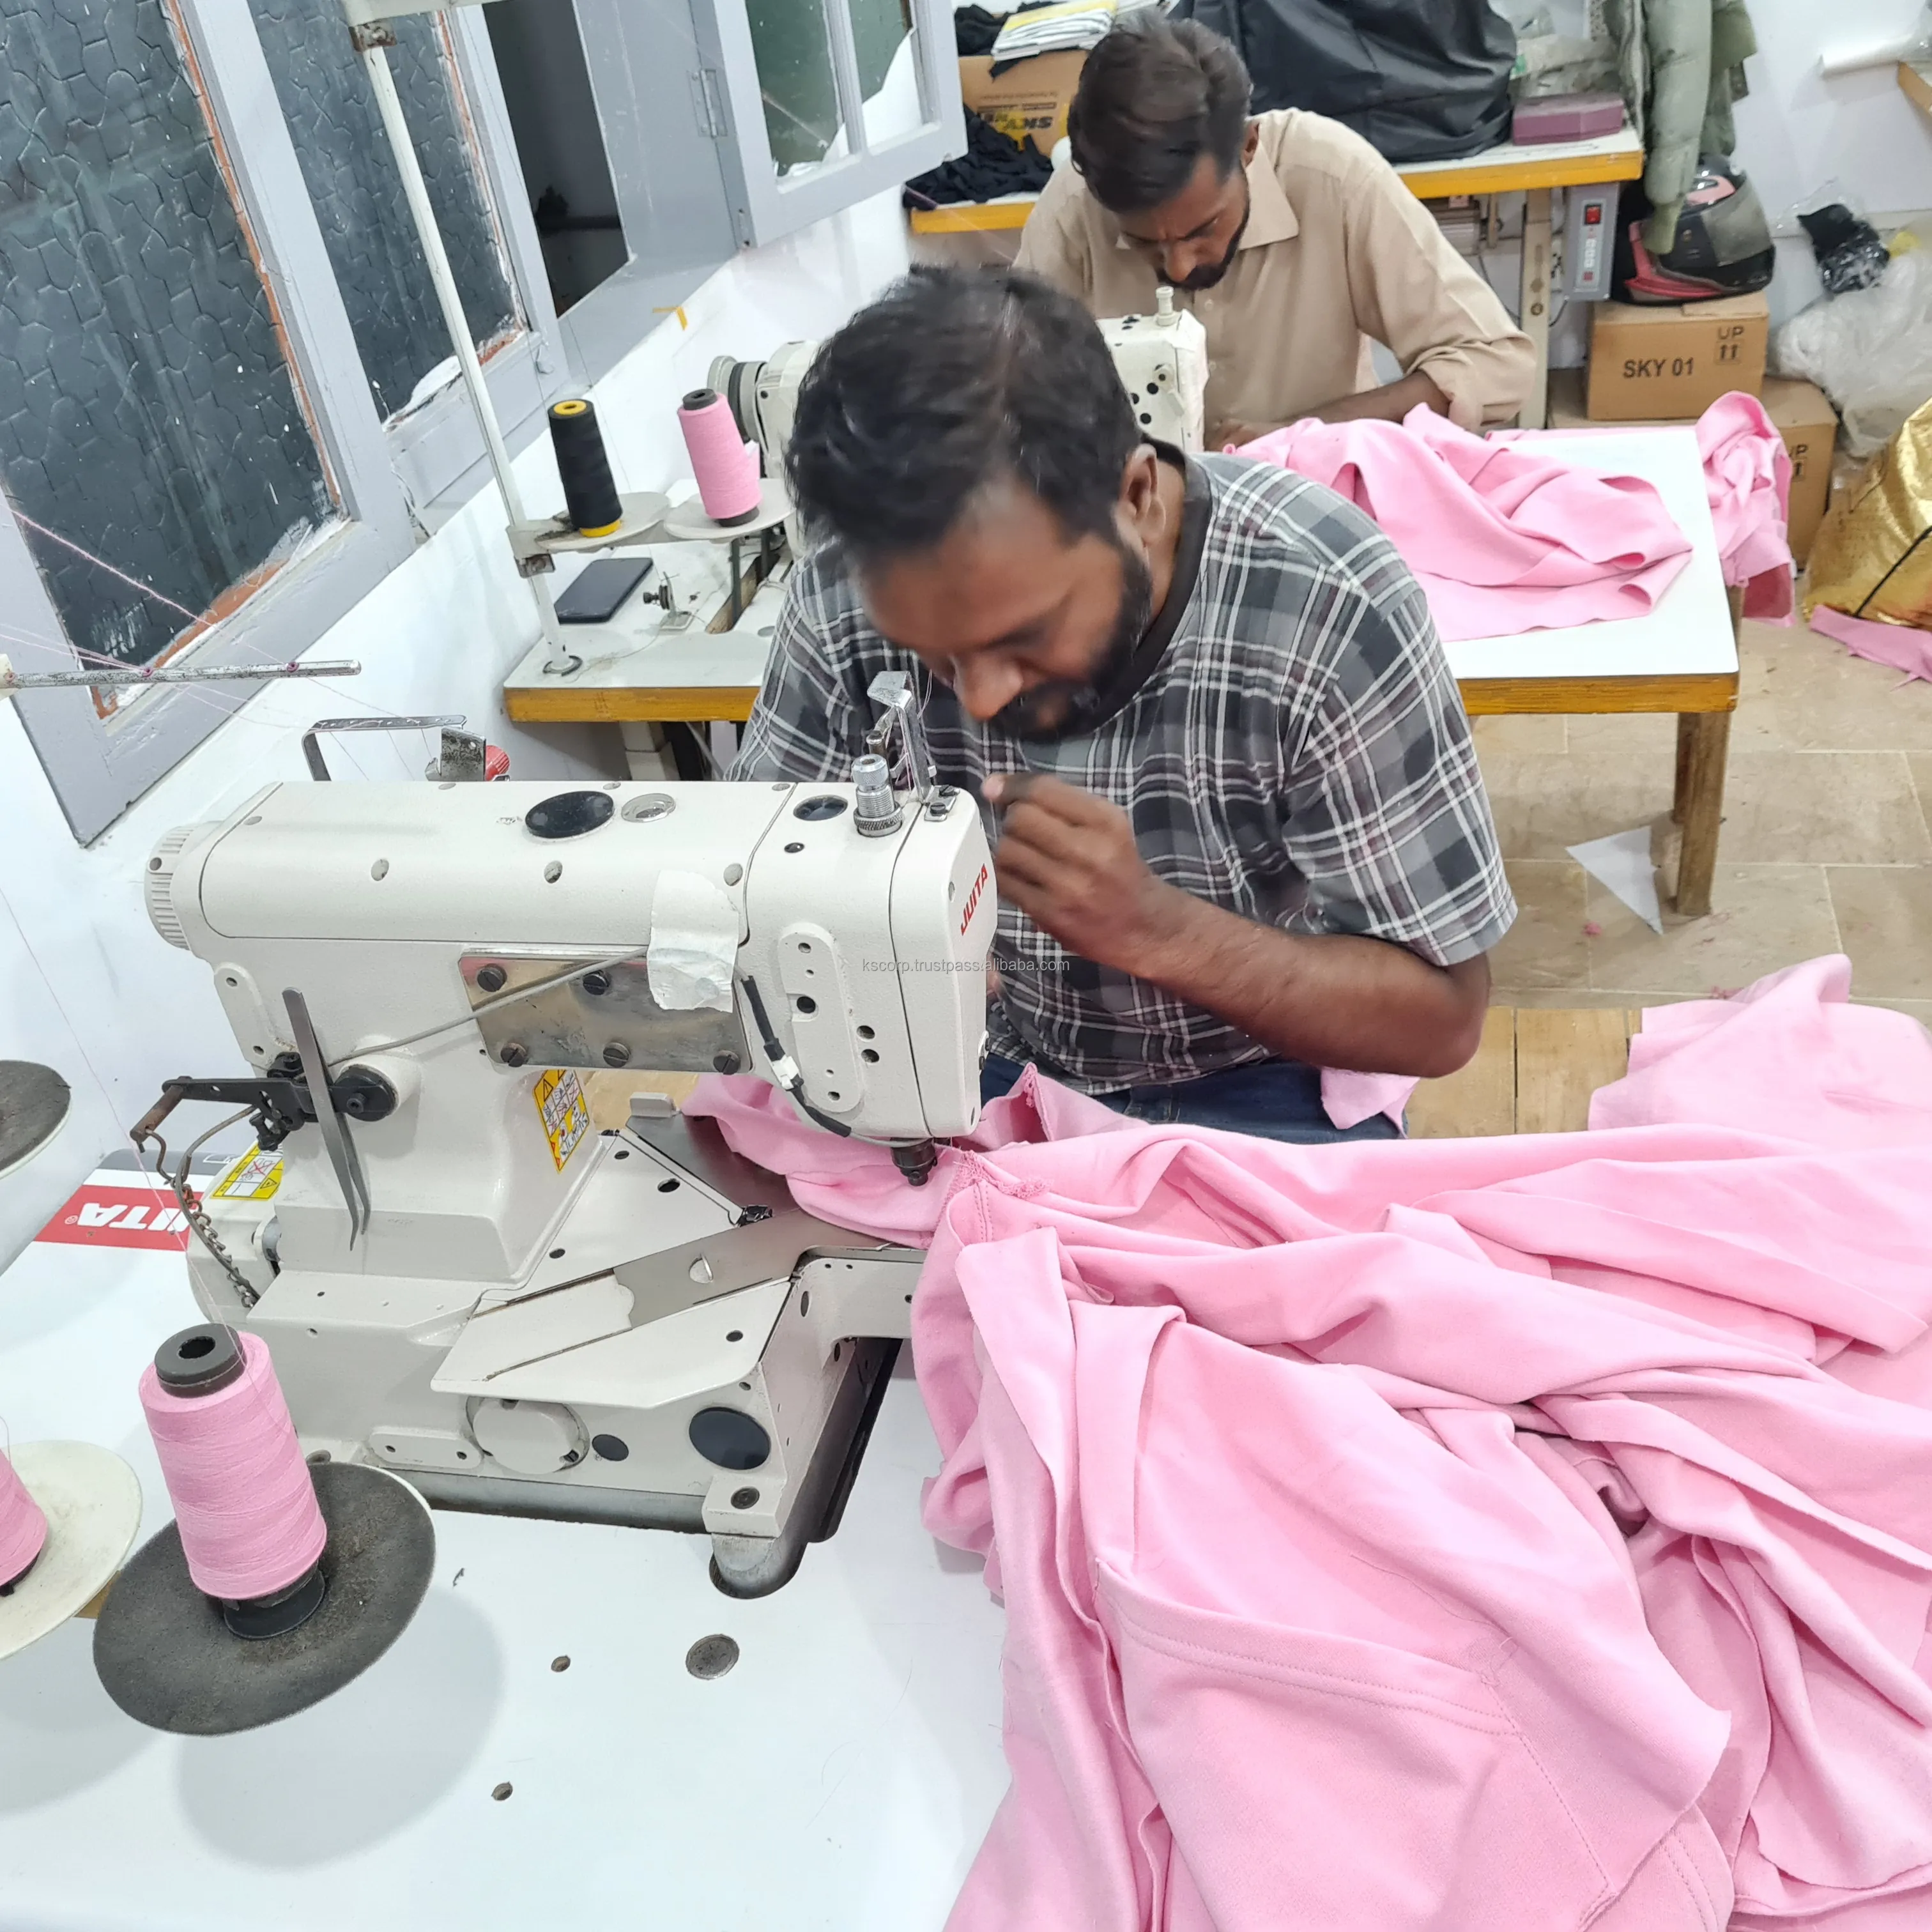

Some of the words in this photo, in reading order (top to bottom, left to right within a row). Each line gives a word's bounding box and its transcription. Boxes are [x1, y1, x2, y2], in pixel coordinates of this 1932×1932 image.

[1717, 325, 1745, 340] UP
[1623, 359, 1666, 378] SKY
[1673, 356, 1694, 376] 01
[961, 863, 987, 936] JUITA
